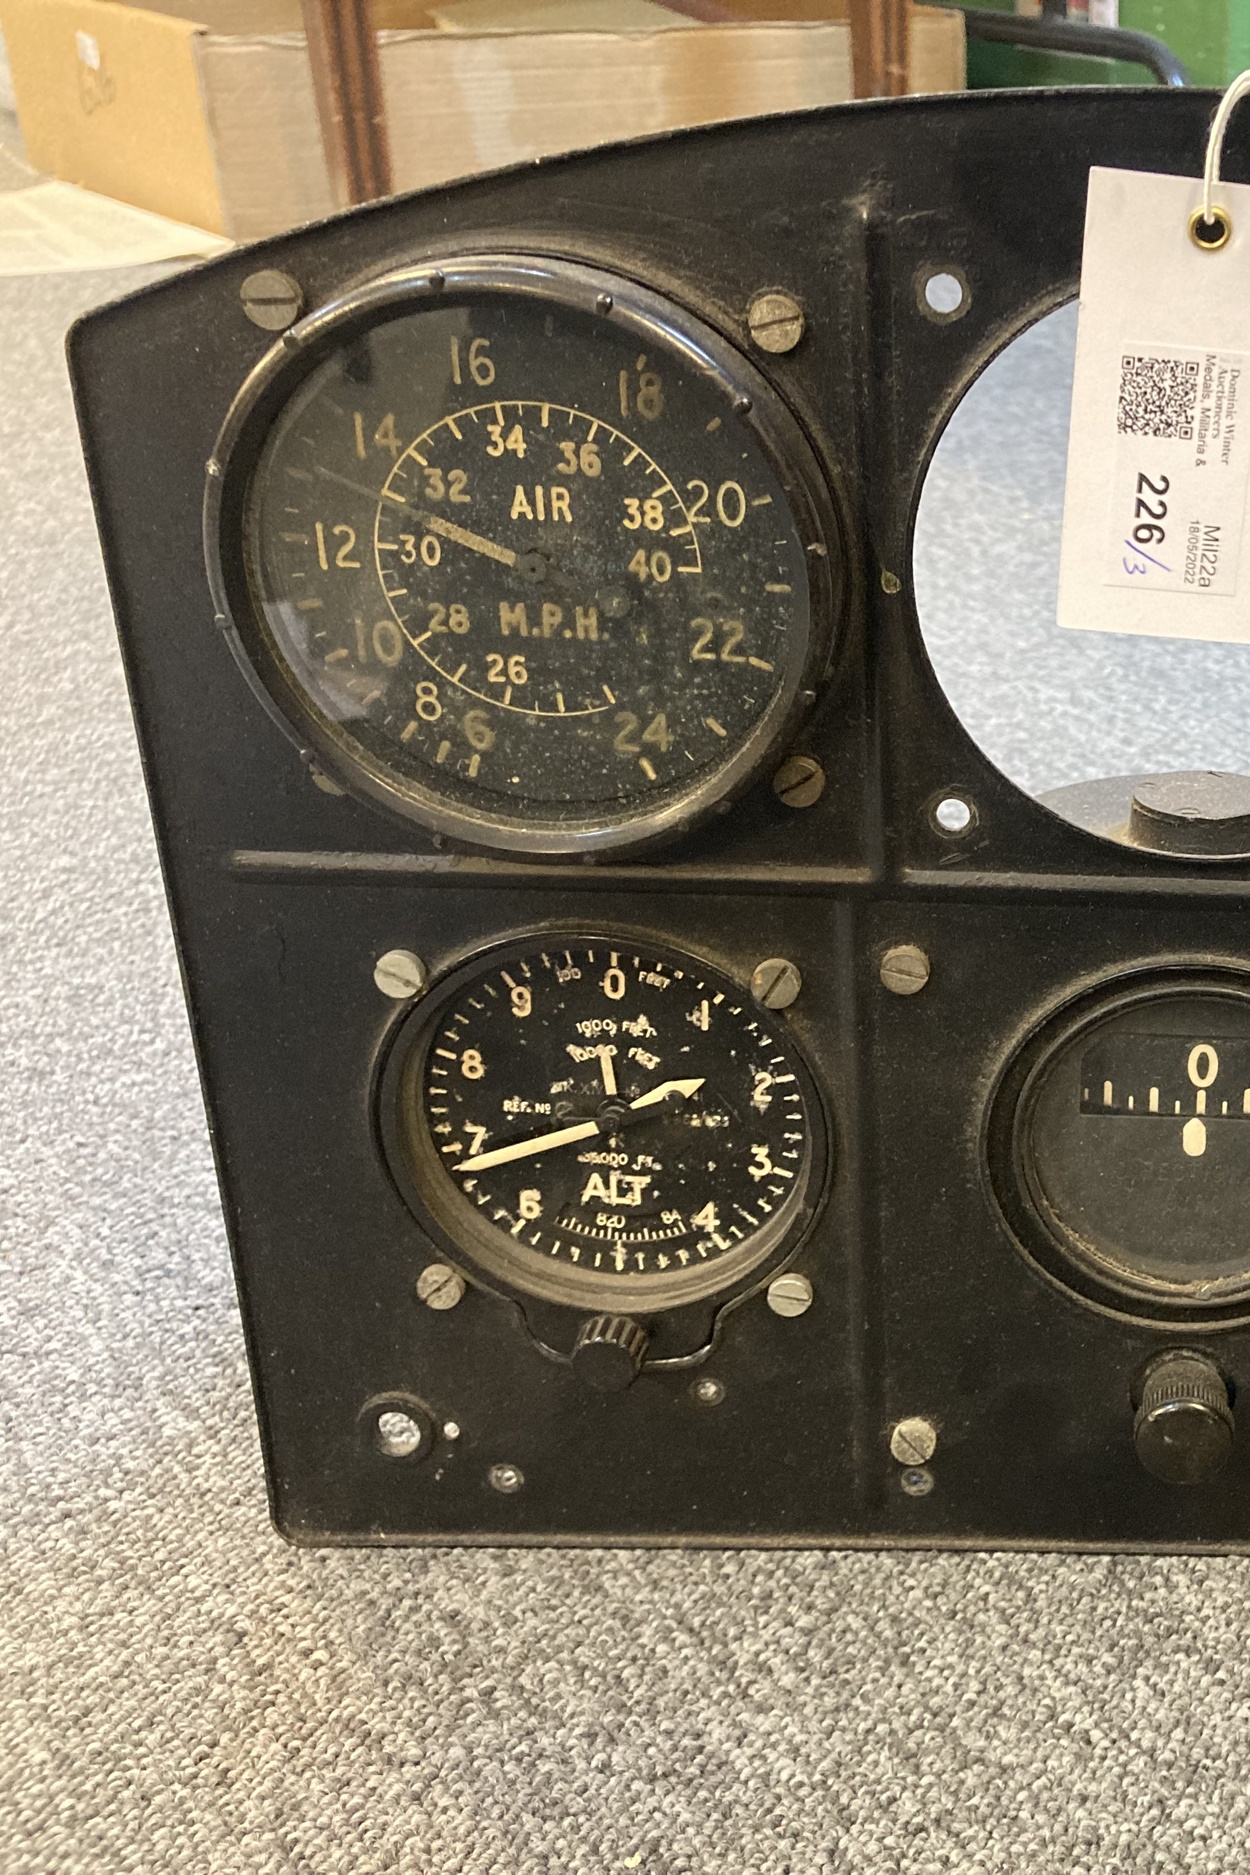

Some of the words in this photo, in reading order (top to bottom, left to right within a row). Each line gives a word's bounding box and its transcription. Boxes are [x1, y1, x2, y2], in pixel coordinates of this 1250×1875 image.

[450, 337, 496, 387] 16
[1200, 354, 1217, 403] Medals,
[619, 371, 664, 420] 18
[1212, 367, 1228, 439] Auctioneers
[1225, 369, 1241, 421] Dominic
[354, 413, 401, 459] 14
[486, 425, 527, 458] 34
[1196, 407, 1211, 455] Militaria
[1221, 424, 1235, 465] Winter
[557, 441, 601, 477] 36
[1195, 458, 1206, 467] &
[424, 469, 471, 503] 32
[510, 485, 573, 523] AIR
[686, 480, 746, 528] 20
[622, 498, 664, 533] 38
[316, 522, 362, 570] 12
[400, 535, 441, 566] 30
[1184, 520, 1200, 584] 18/05/2022
[1198, 525, 1221, 588] Mil22a
[628, 549, 672, 583] 40
[428, 602, 470, 634] 28
[354, 621, 402, 666] 10
[690, 618, 746, 661] 22
[486, 654, 528, 684] 26
[415, 681, 443, 721] 8
[464, 710, 493, 752] 6
[613, 711, 673, 752] 24
[510, 985, 532, 1018] 9
[603, 967, 626, 1000] 0
[461, 1048, 485, 1080] 8
[1187, 1044, 1219, 1087] 0
[753, 1071, 774, 1103] 2
[463, 1125, 487, 1155] 7
[749, 1145, 773, 1176] 3
[518, 1187, 541, 1219] 6
[580, 1170, 651, 1206] ALT
[692, 1201, 720, 1233] 4
